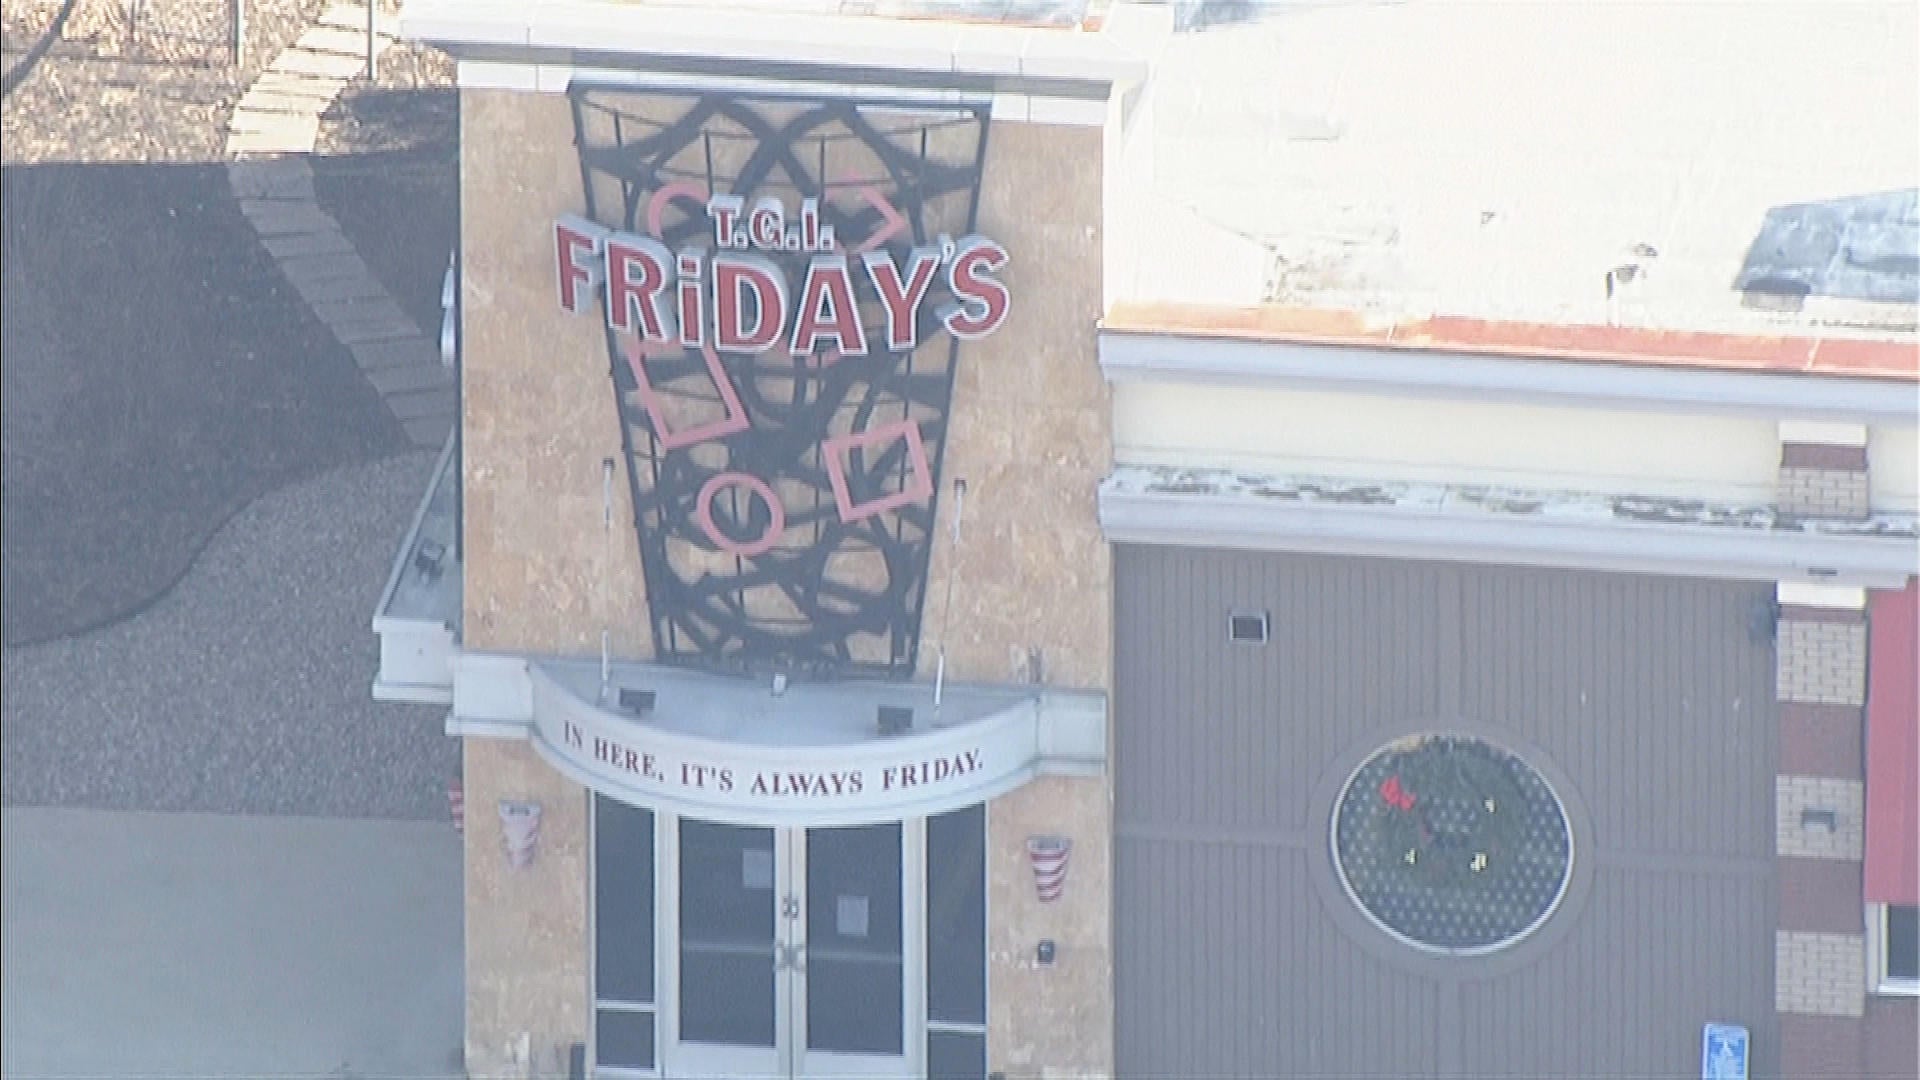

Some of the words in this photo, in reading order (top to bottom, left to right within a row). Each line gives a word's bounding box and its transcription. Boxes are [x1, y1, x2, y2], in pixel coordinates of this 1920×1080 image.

[707, 196, 834, 250] T.G.I.
[564, 719, 584, 749] IN
[594, 736, 665, 783] HERE,
[681, 761, 734, 792] IT'S
[751, 769, 863, 796] ALWAYS
[882, 747, 983, 791] FRIDAY.
